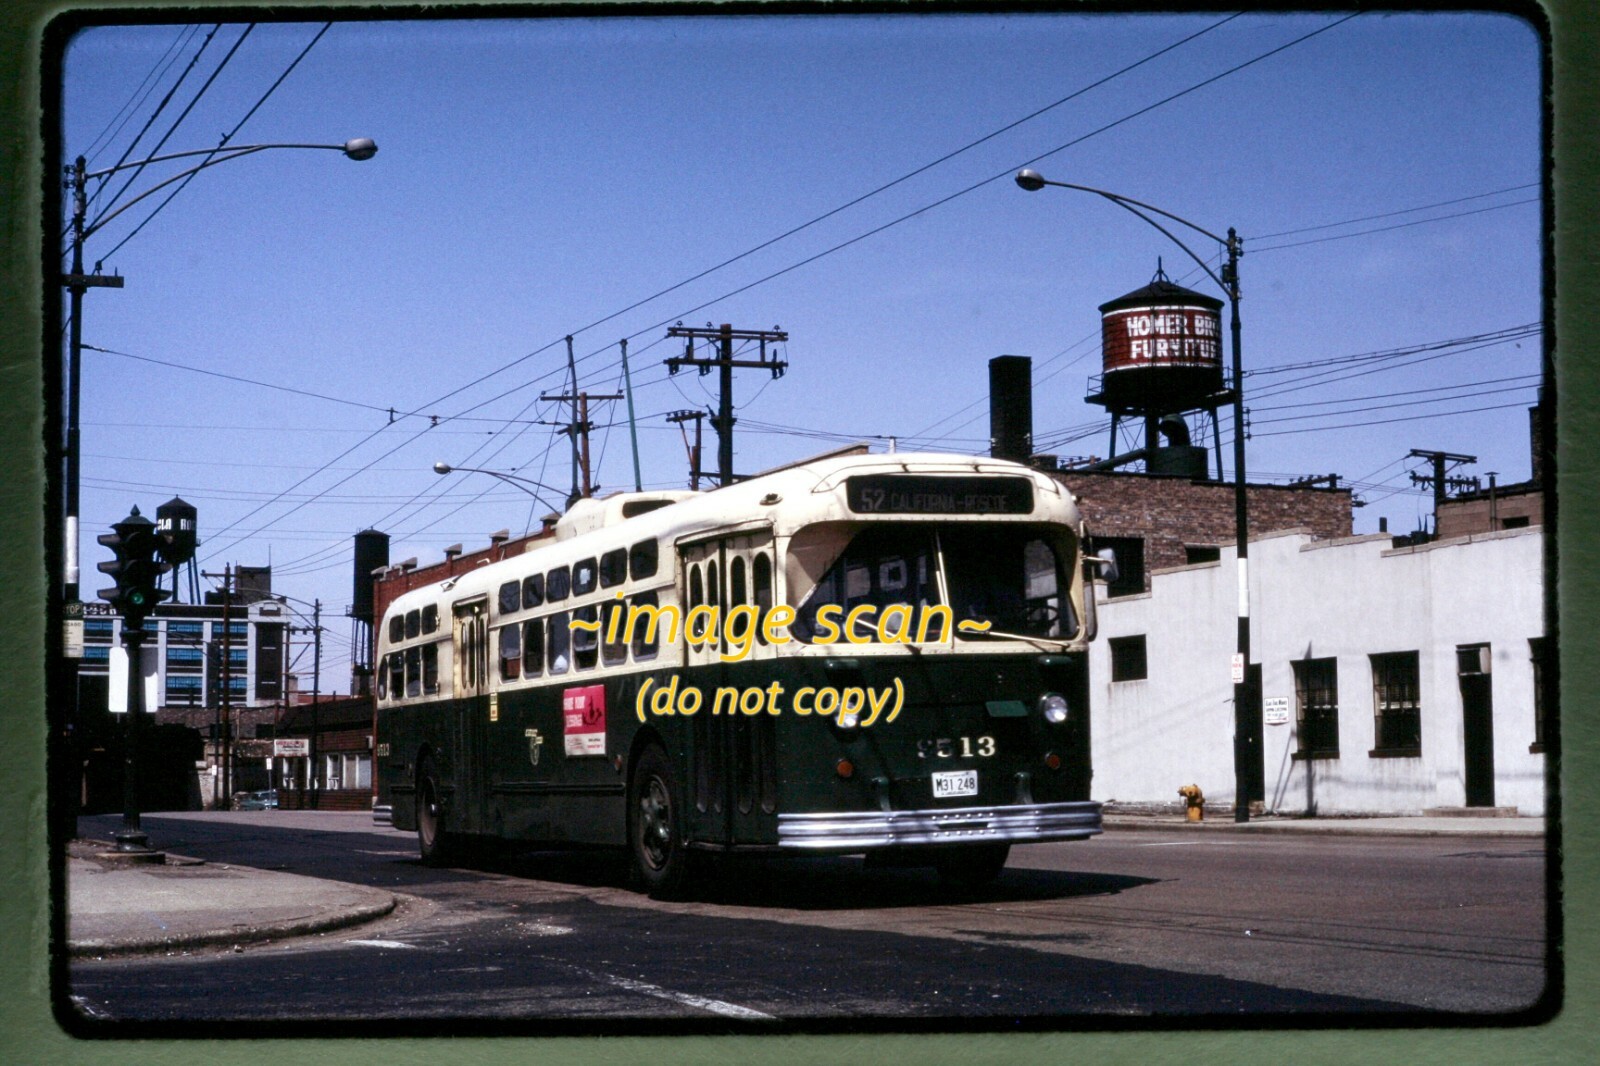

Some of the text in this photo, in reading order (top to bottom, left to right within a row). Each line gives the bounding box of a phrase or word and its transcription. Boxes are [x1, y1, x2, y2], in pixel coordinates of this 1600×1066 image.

[1126, 314, 1189, 337] HOMER
[861, 489, 886, 512] 52
[958, 777, 975, 790] 248
